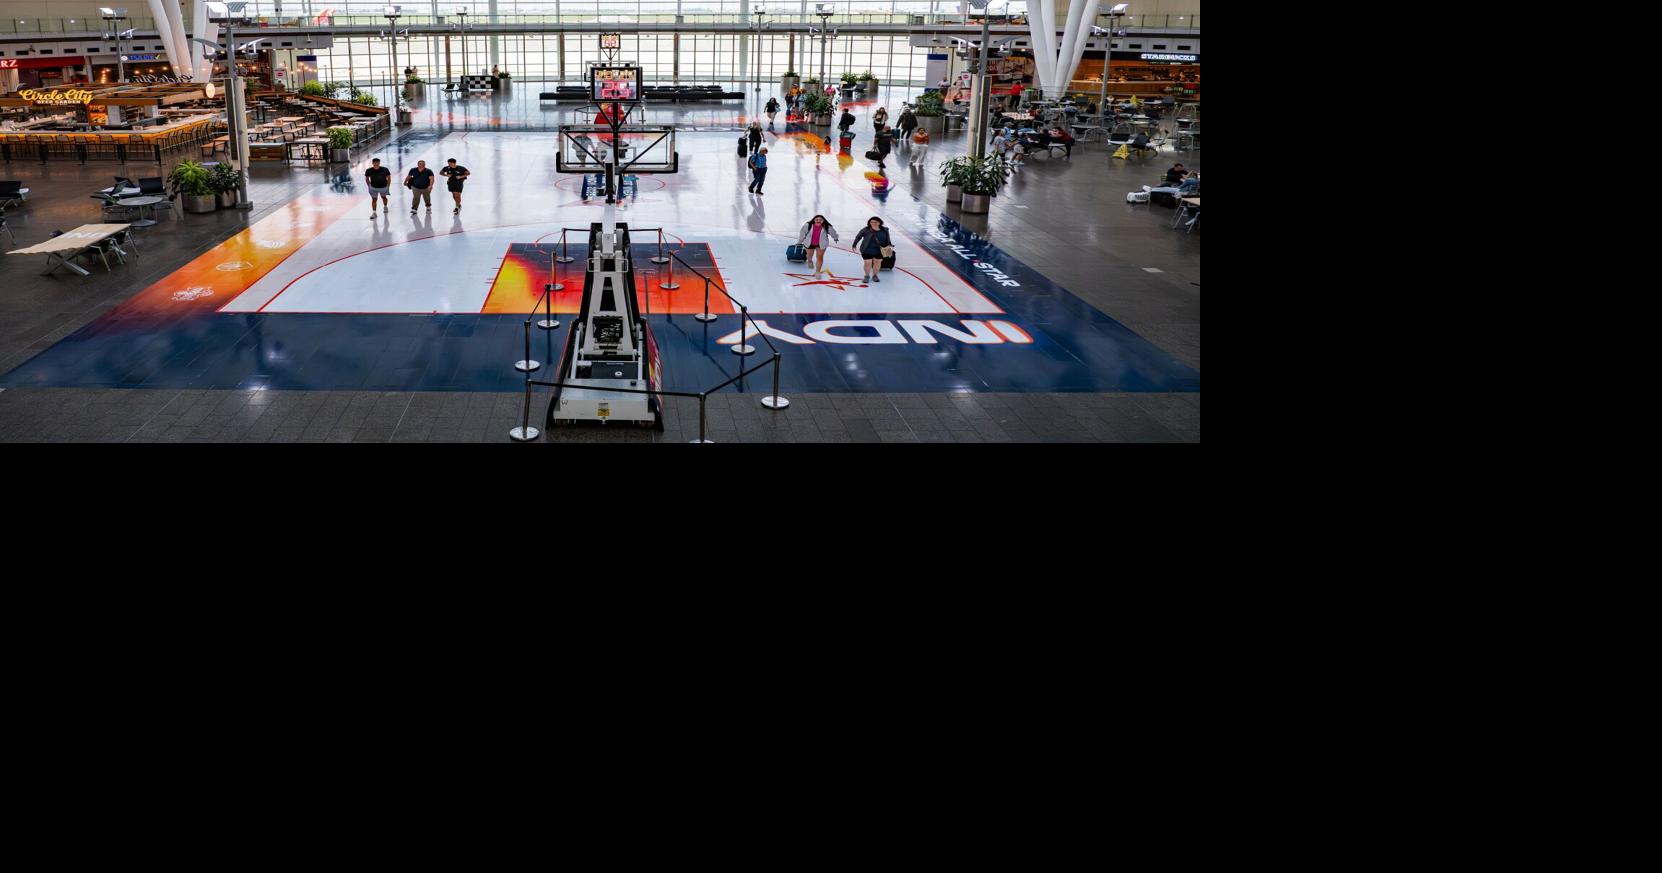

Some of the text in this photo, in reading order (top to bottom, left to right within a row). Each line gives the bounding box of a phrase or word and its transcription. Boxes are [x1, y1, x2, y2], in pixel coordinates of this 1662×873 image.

[1141, 53, 1196, 61] STARBUCKS
[18, 88, 94, 104] Circle City
[946, 243, 977, 260] ALL
[974, 262, 1020, 287] STAR
[717, 320, 1033, 345] INDY
